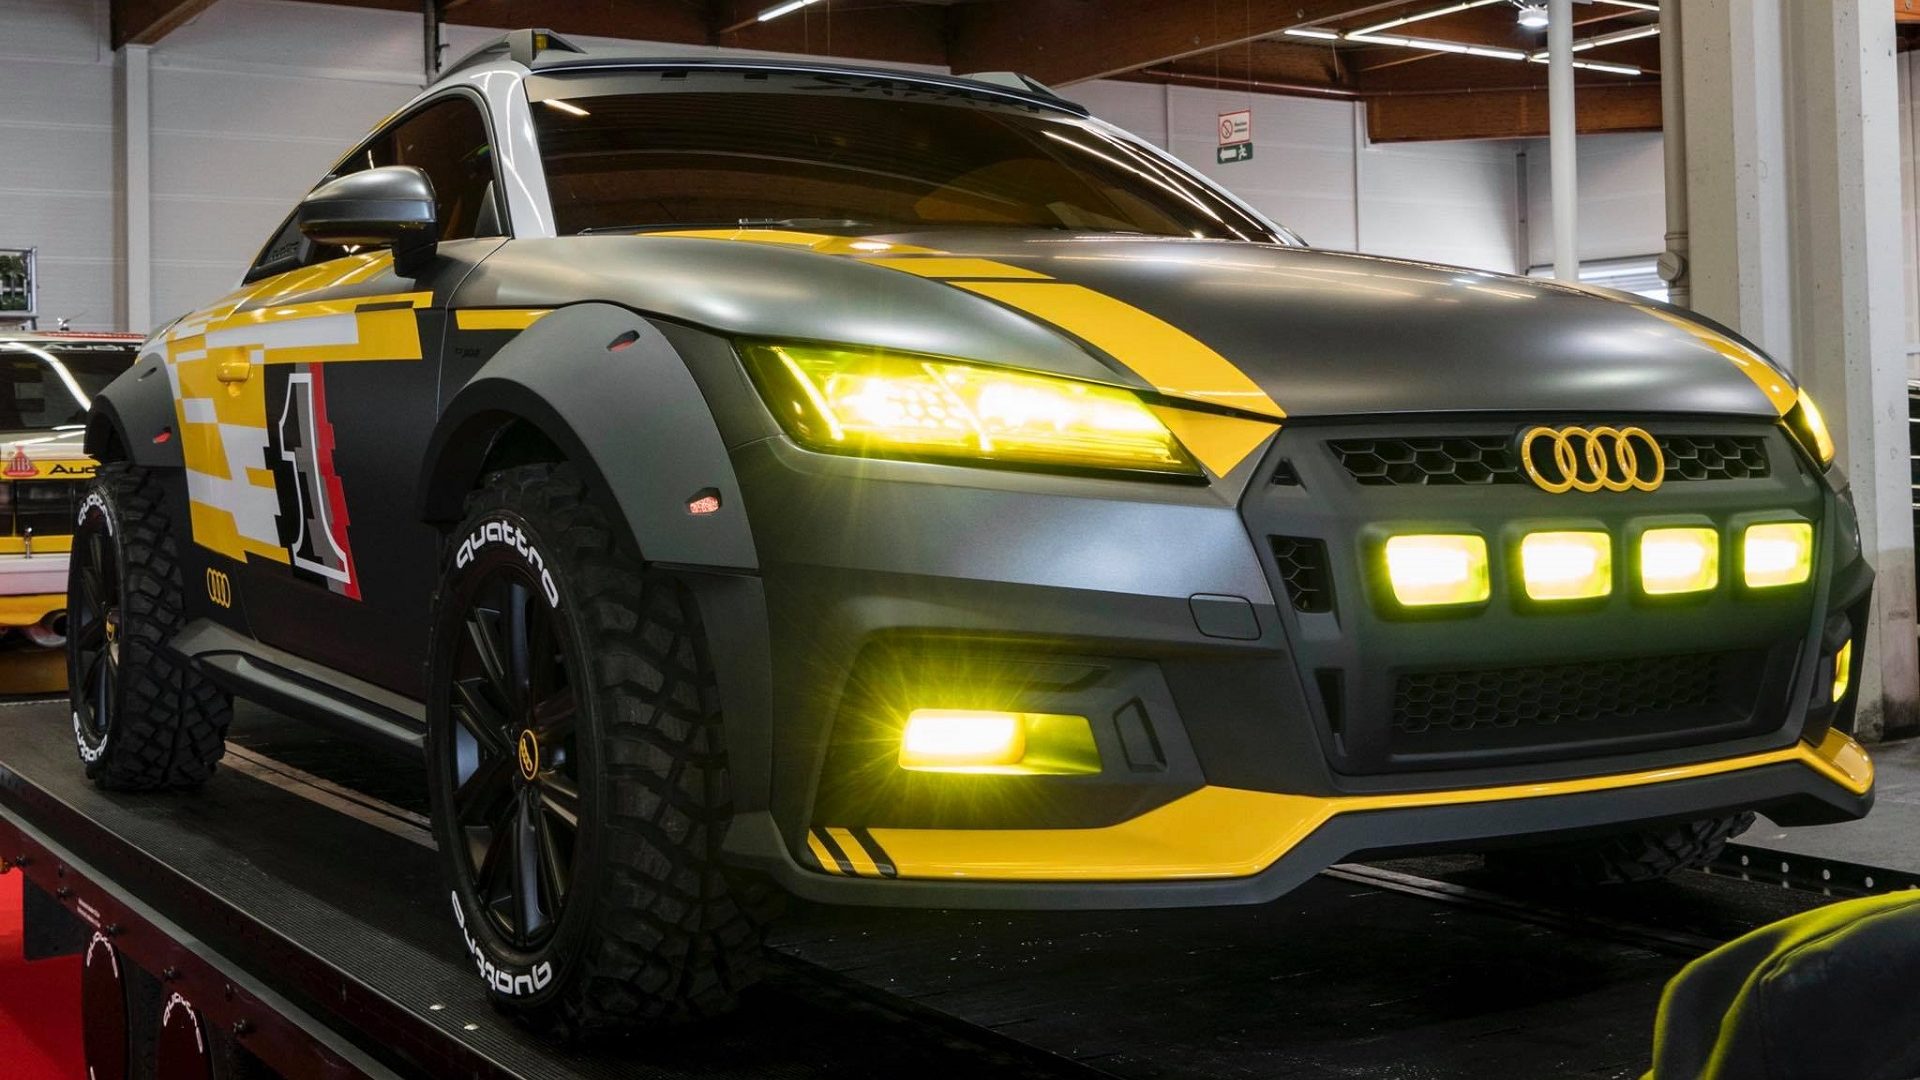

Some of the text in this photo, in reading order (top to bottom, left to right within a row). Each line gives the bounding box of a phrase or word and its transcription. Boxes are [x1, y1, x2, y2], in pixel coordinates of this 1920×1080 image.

[48, 464, 97, 475] Aud
[278, 372, 351, 585] 1
[455, 520, 559, 609] quattro
[451, 890, 553, 997] quattro
